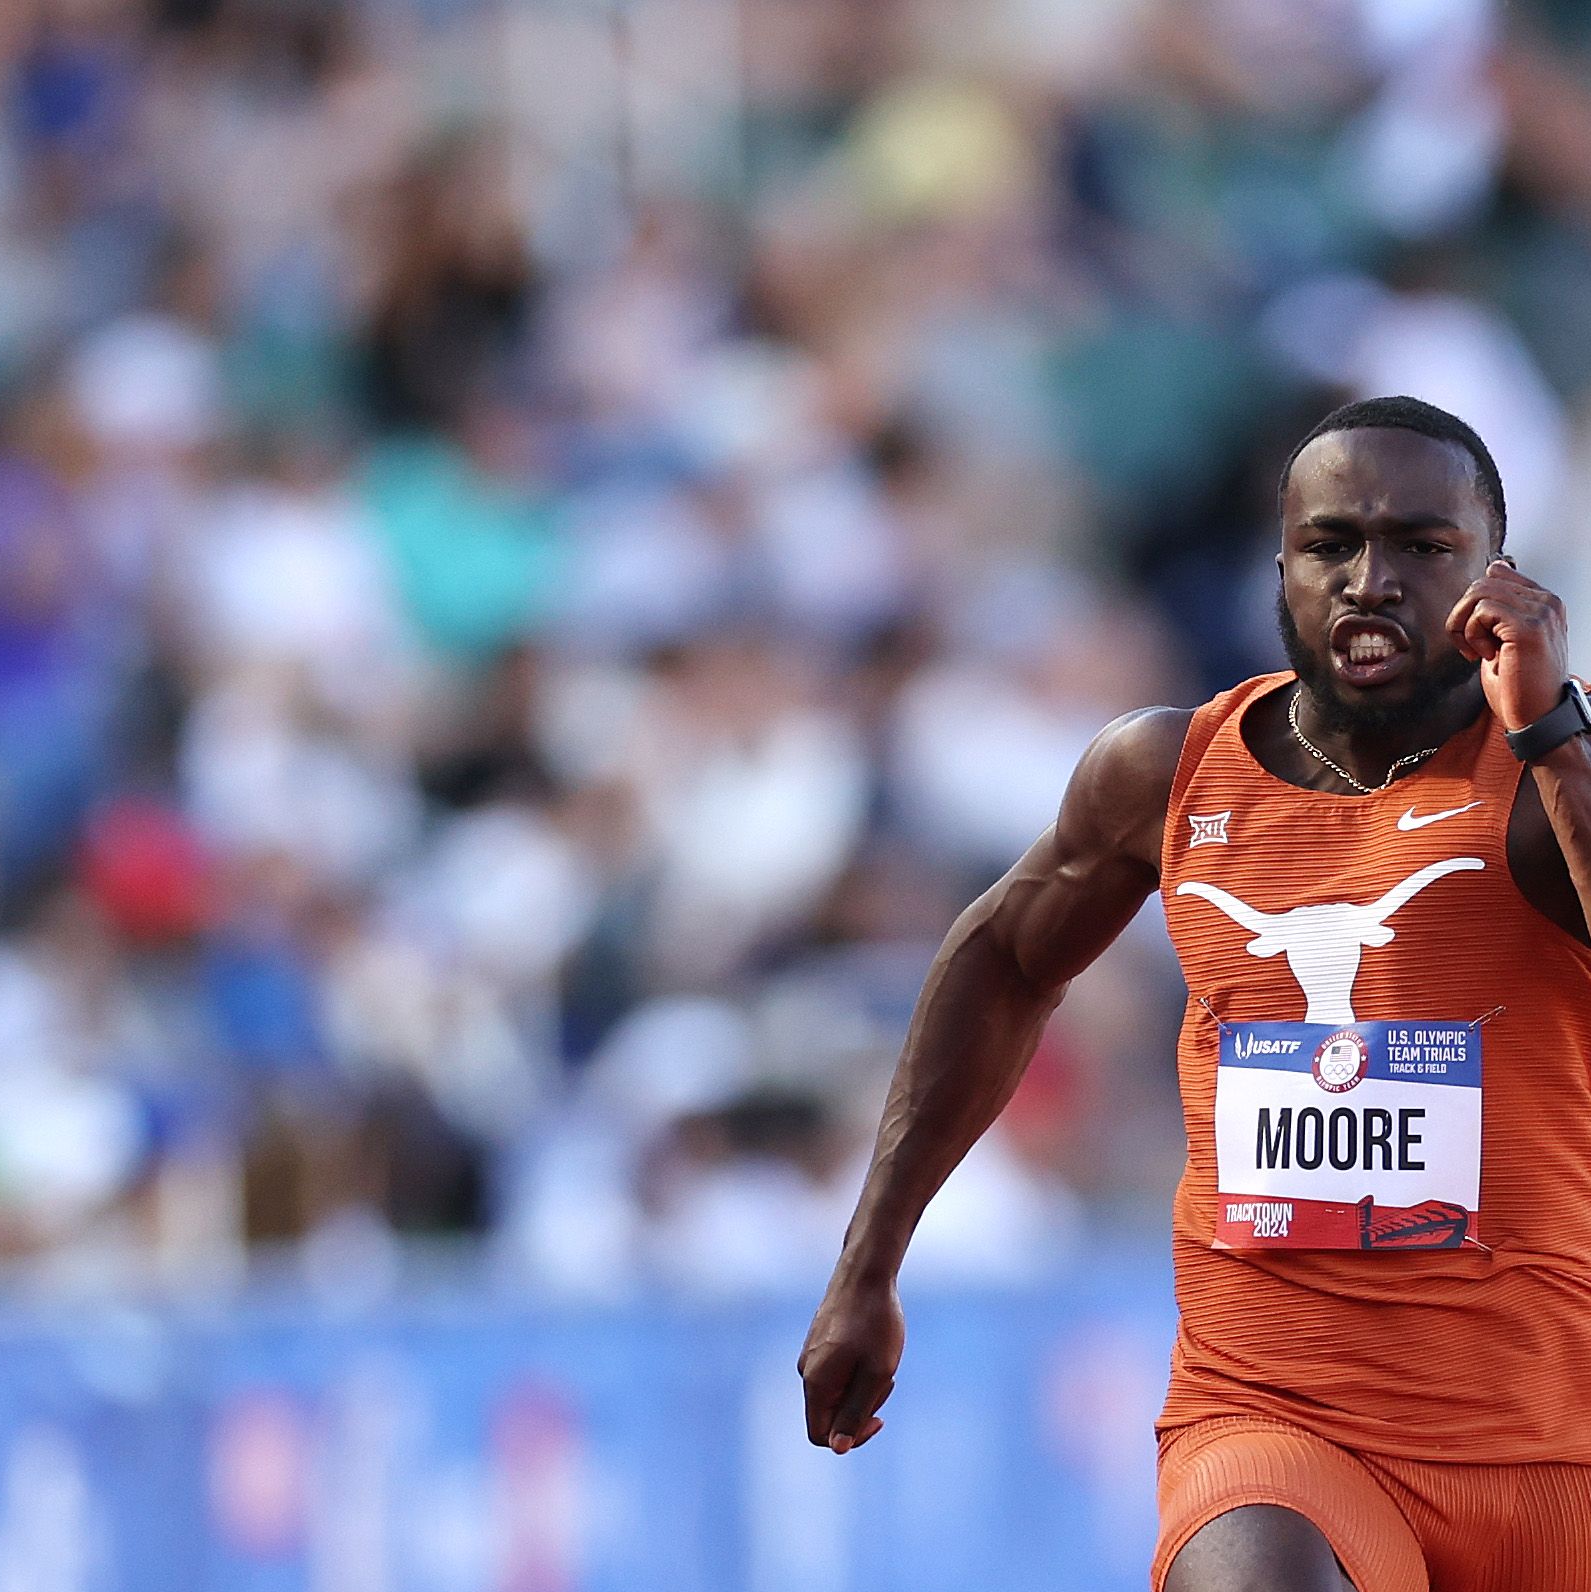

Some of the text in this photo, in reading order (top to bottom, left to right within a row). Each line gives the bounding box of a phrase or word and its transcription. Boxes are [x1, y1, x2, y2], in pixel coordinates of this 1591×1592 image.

[1387, 1030, 1466, 1045] U.S. OLYMPIC
[1251, 1040, 1301, 1055] USATF
[1387, 1047, 1466, 1062] TEAM TRIALS
[1389, 1063, 1416, 1074] TRACK
[1425, 1063, 1447, 1074] FIELD
[1256, 1106, 1426, 1171] MOORE
[1226, 1203, 1293, 1223] TRACKTOWN
[1253, 1219, 1288, 1238] 2024
